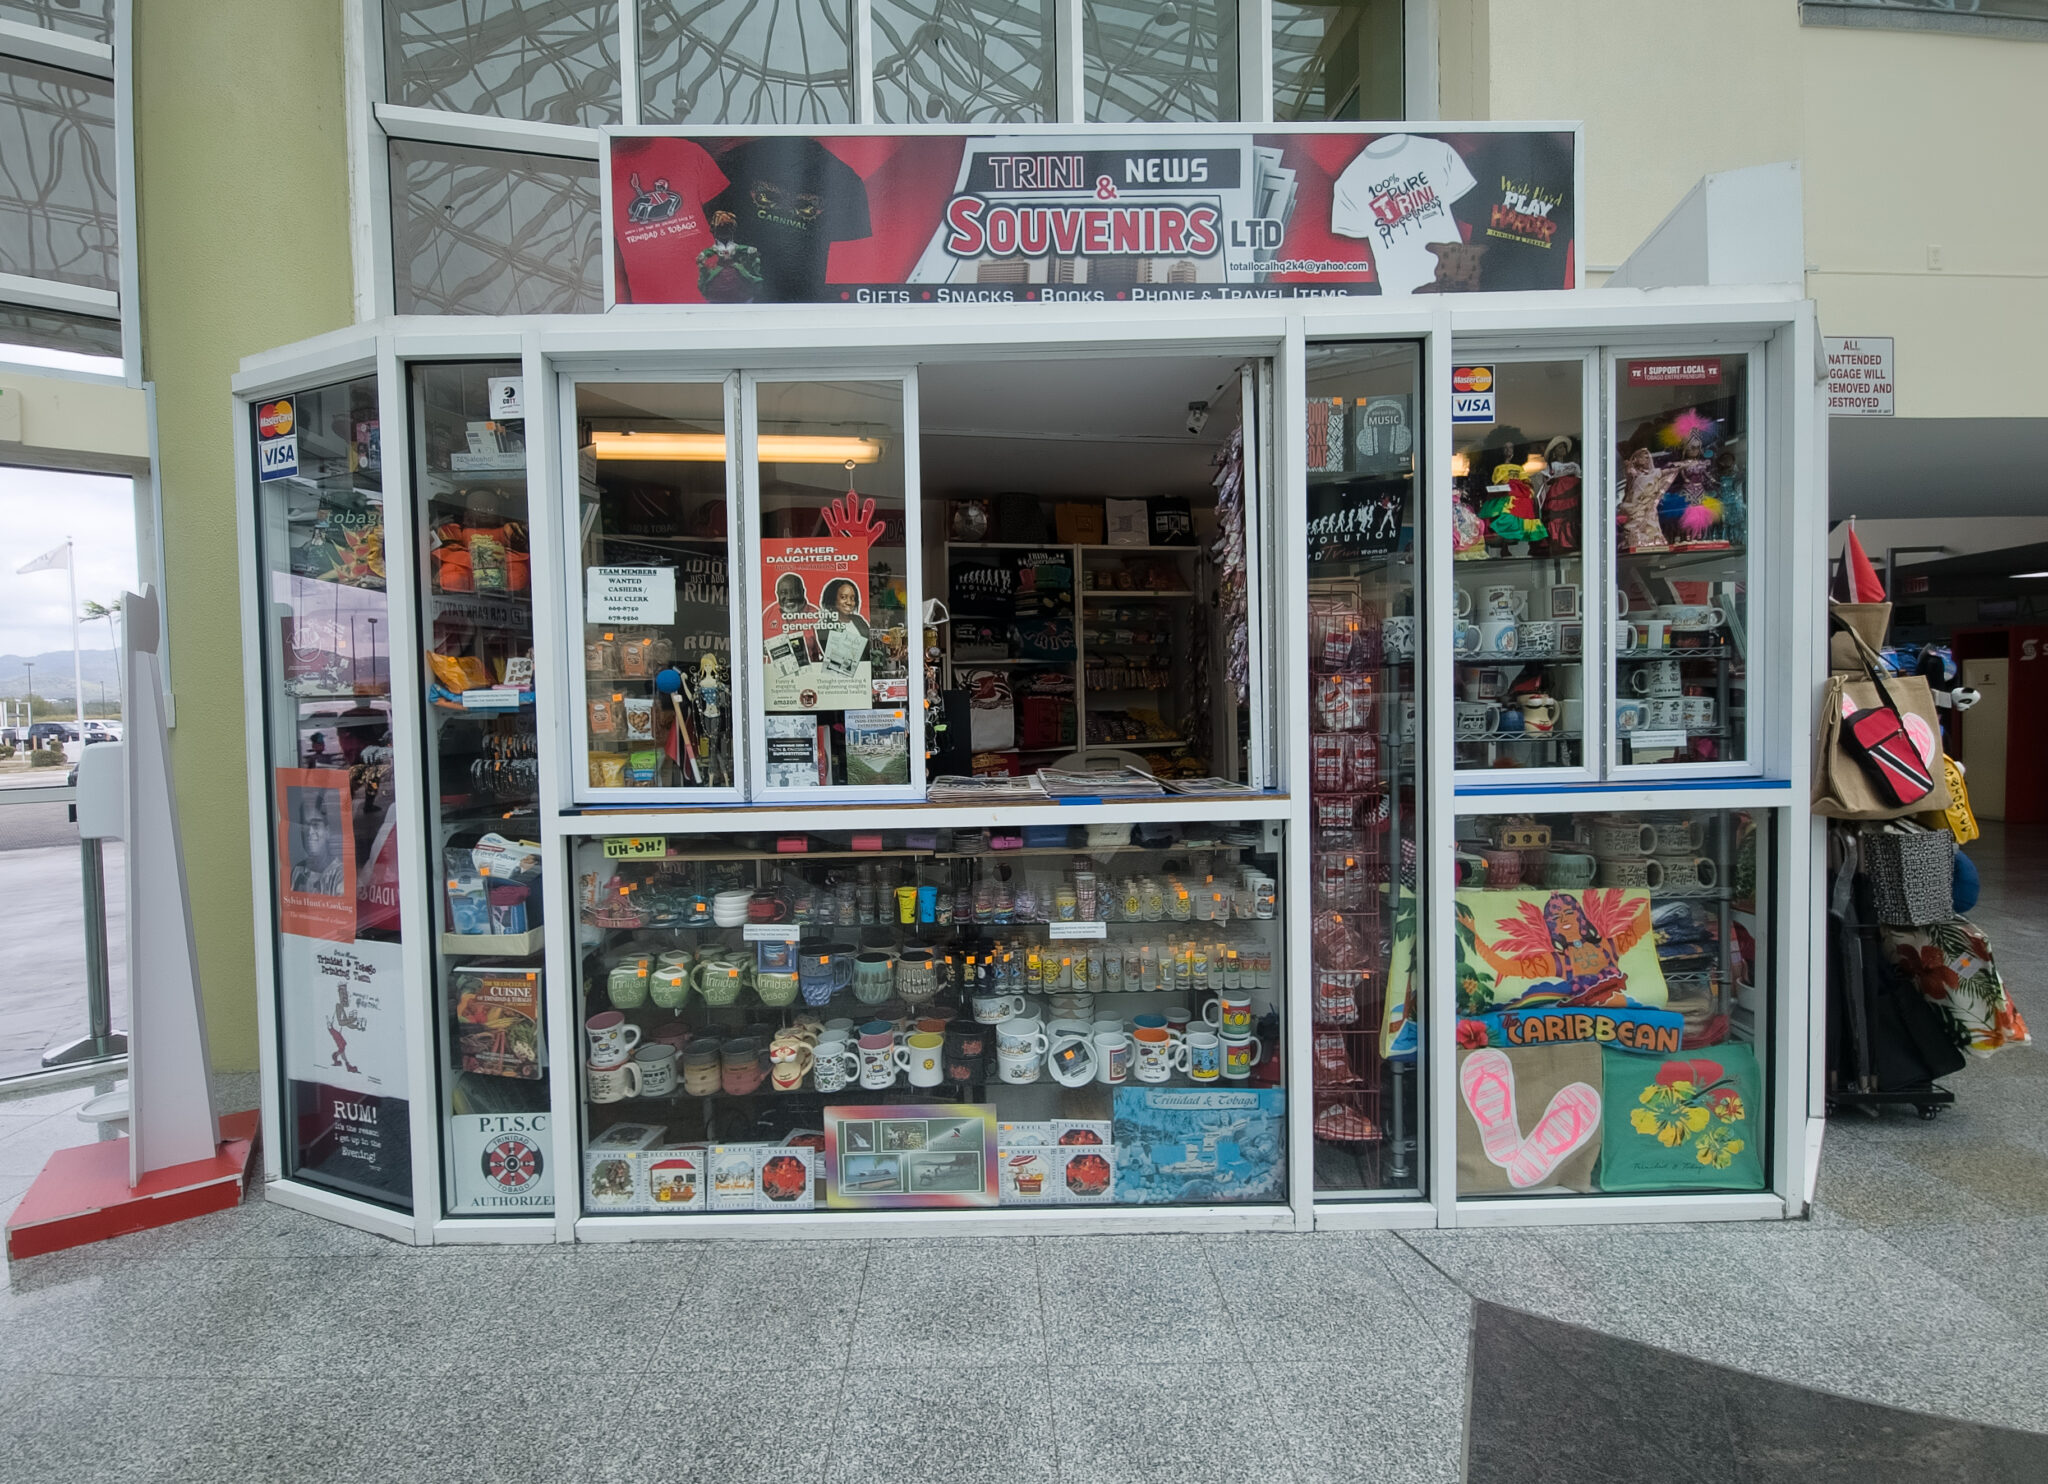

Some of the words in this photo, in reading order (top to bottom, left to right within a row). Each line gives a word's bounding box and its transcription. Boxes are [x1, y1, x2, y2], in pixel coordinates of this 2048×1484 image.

[989, 156, 1084, 188] TRINI
[1097, 176, 1117, 200] &
[1125, 157, 1209, 183] NEWS
[1368, 173, 1400, 198] 100%
[1387, 171, 1429, 201] PURE
[1368, 186, 1435, 224] TRINI
[1504, 191, 1554, 217] PLAY
[757, 210, 807, 231] CARNIVAL
[946, 197, 1220, 257] SOUVENIRS
[1491, 204, 1557, 243] HARDER
[626, 231, 658, 244] TRINIDAD
[668, 221, 697, 234] TOBAGO
[1231, 220, 1283, 248] LTD
[1229, 261, 1368, 273] totallocalhq2k4@yahoo.com
[856, 288, 910, 303] GIFTS
[937, 288, 1014, 303] SNACKS
[1041, 288, 1105, 302] BOOKS
[1131, 288, 1196, 300] PHONE
[1201, 291, 1212, 300] &
[1217, 288, 1283, 299] TRAVEL
[1293, 288, 1348, 298] ITEMS
[1843, 340, 1860, 350] ALL
[1828, 354, 1882, 365] NATTENDED
[1648, 366, 1681, 375] SUPPORT
[1683, 365, 1705, 374] LOCAL
[1829, 369, 1862, 379] GGAGE
[1864, 369, 1886, 379] WILL
[1453, 375, 1492, 385] MasterCard
[1828, 383, 1870, 393] REMOVED
[1873, 384, 1892, 393] AND
[1456, 399, 1491, 412] VISA
[260, 413, 293, 428] MasterCard
[1368, 415, 1400, 425] MUSIC
[264, 444, 295, 466] VISA
[1308, 530, 1396, 545] VOLUTION
[786, 546, 839, 555] FATHER-
[1360, 548, 1388, 556] Woman
[766, 555, 832, 564] DAUGHTER
[833, 554, 859, 562] DUO
[598, 568, 620, 576] TEAM
[621, 568, 657, 576] MEMBERS
[690, 574, 707, 584] JUST
[711, 574, 725, 584] ADD
[955, 584, 1013, 594] EVOLUTION
[781, 609, 839, 622] connecting
[781, 621, 846, 633] generations
[607, 838, 664, 856] UH-OH!
[317, 954, 343, 967] Trinidad
[354, 961, 377, 976] Tobago
[321, 965, 350, 981] Drinking
[705, 972, 740, 988] Trinidad
[490, 986, 532, 997] CUISINE
[1507, 1013, 1680, 1053] CARIBBEAN
[1152, 1094, 1201, 1105] Trinidad
[1203, 1095, 1213, 1107] &
[1217, 1094, 1257, 1107] Tobago
[333, 1100, 377, 1124] RUM!
[479, 1115, 546, 1132] P.T.S.C
[358, 1127, 380, 1137] reason
[492, 1134, 530, 1146] TRINIDAD
[497, 1183, 530, 1193] TOBAGO
